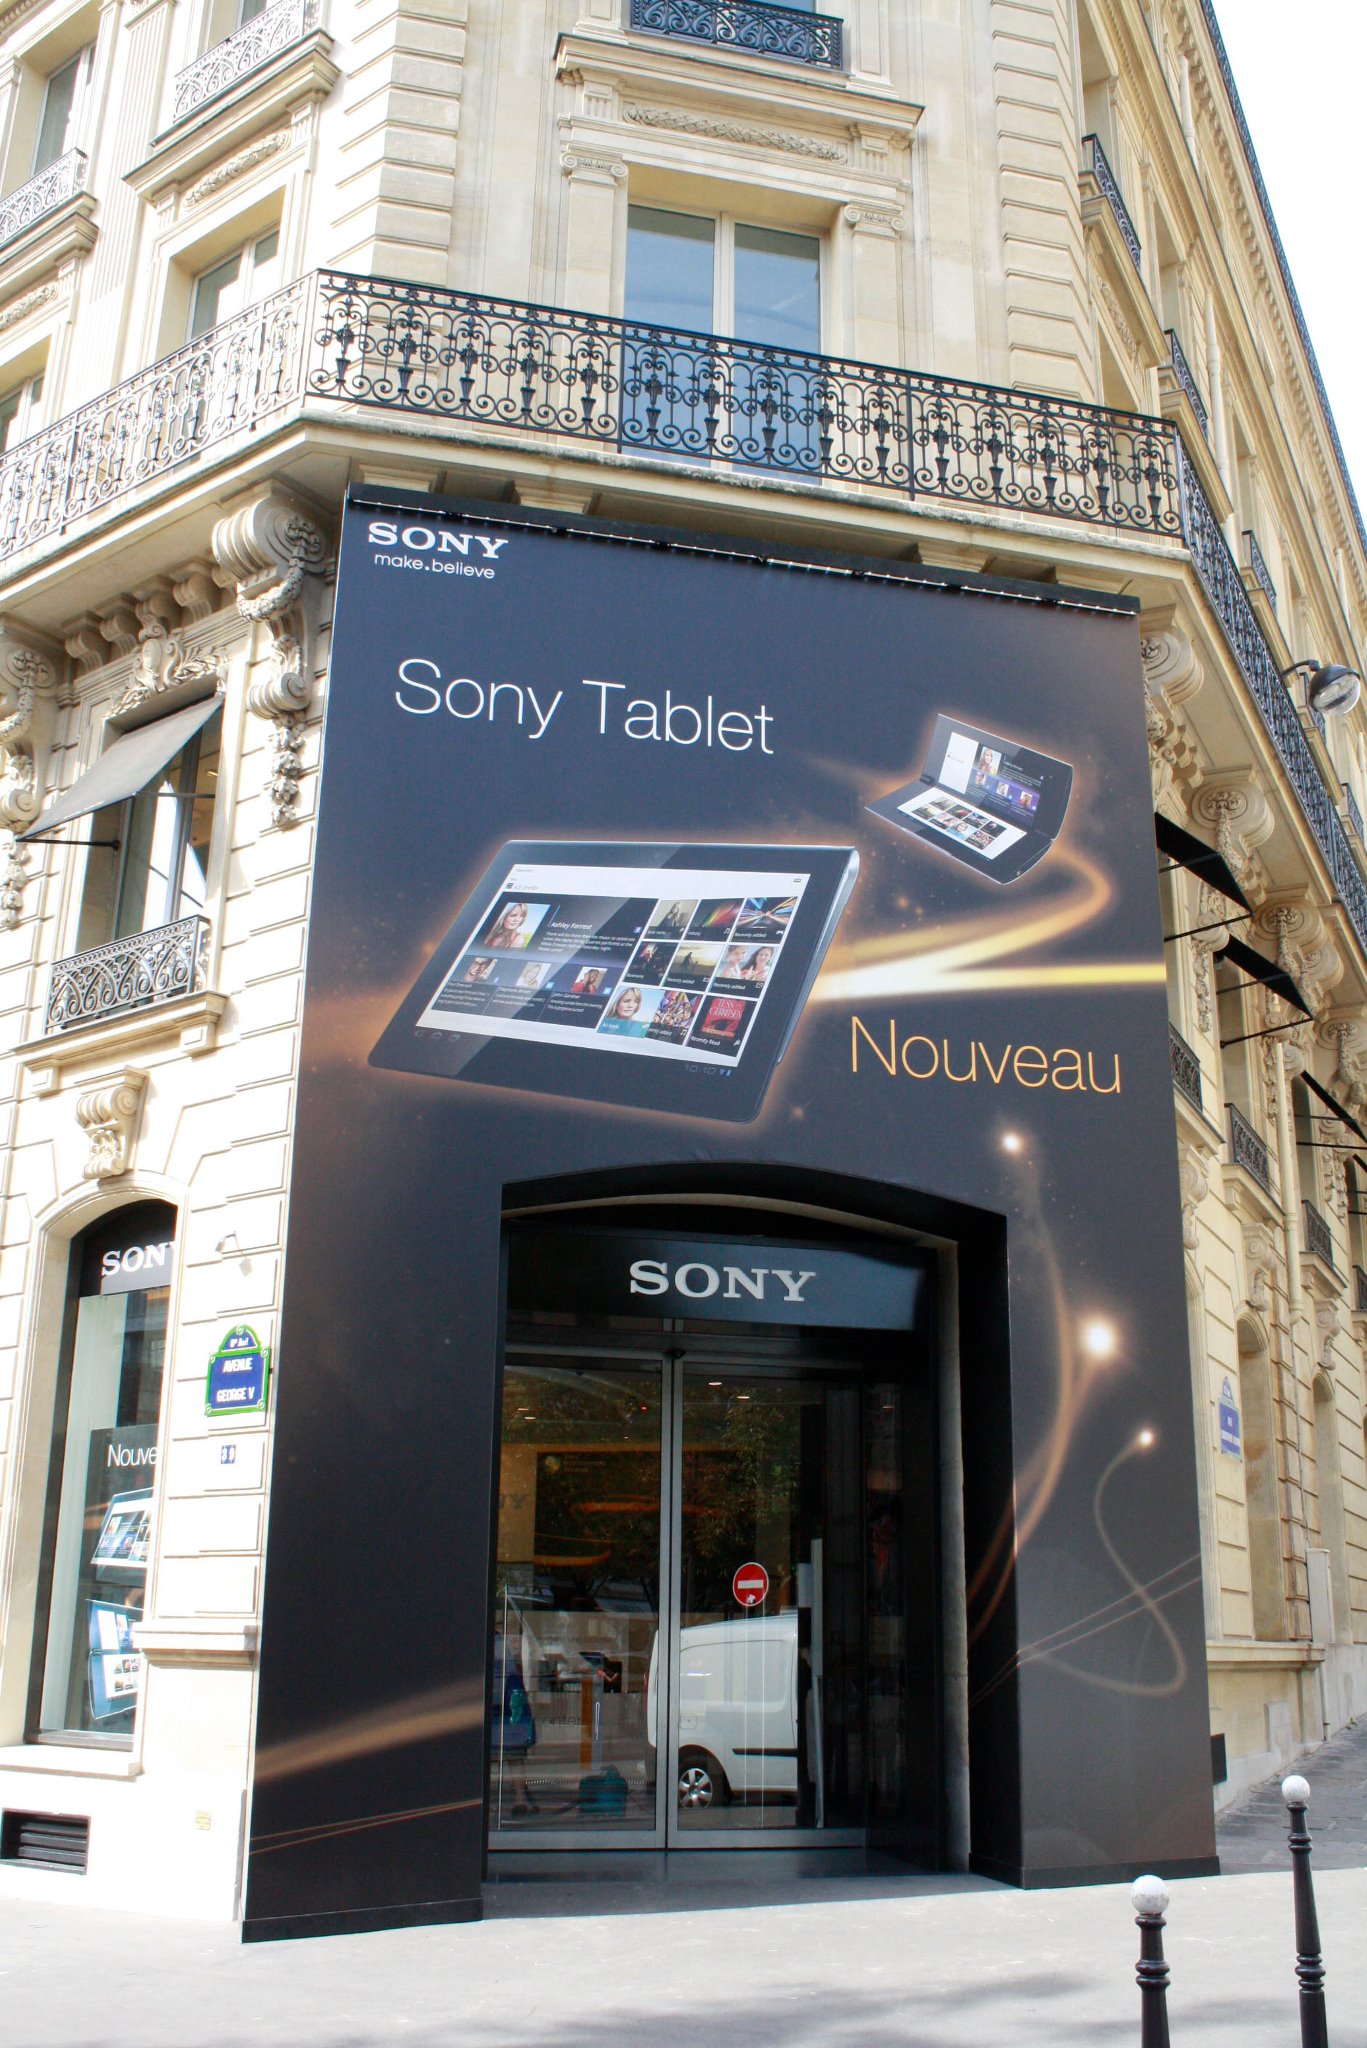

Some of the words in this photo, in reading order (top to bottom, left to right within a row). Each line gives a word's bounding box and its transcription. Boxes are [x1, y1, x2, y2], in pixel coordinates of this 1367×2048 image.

[368, 521, 509, 559] SONY
[374, 554, 496, 579] make.believe
[395, 658, 563, 739] Sony
[582, 679, 774, 754] Tablet
[551, 921, 570, 929] Ashley
[570, 922, 593, 930] Forrest
[851, 1016, 1121, 1094] Nouveau
[101, 1241, 175, 1277] SON
[629, 1260, 816, 1302] SONY
[222, 1357, 253, 1373] AVENUE
[216, 1387, 247, 1402] GEORGE
[248, 1386, 255, 1400] V
